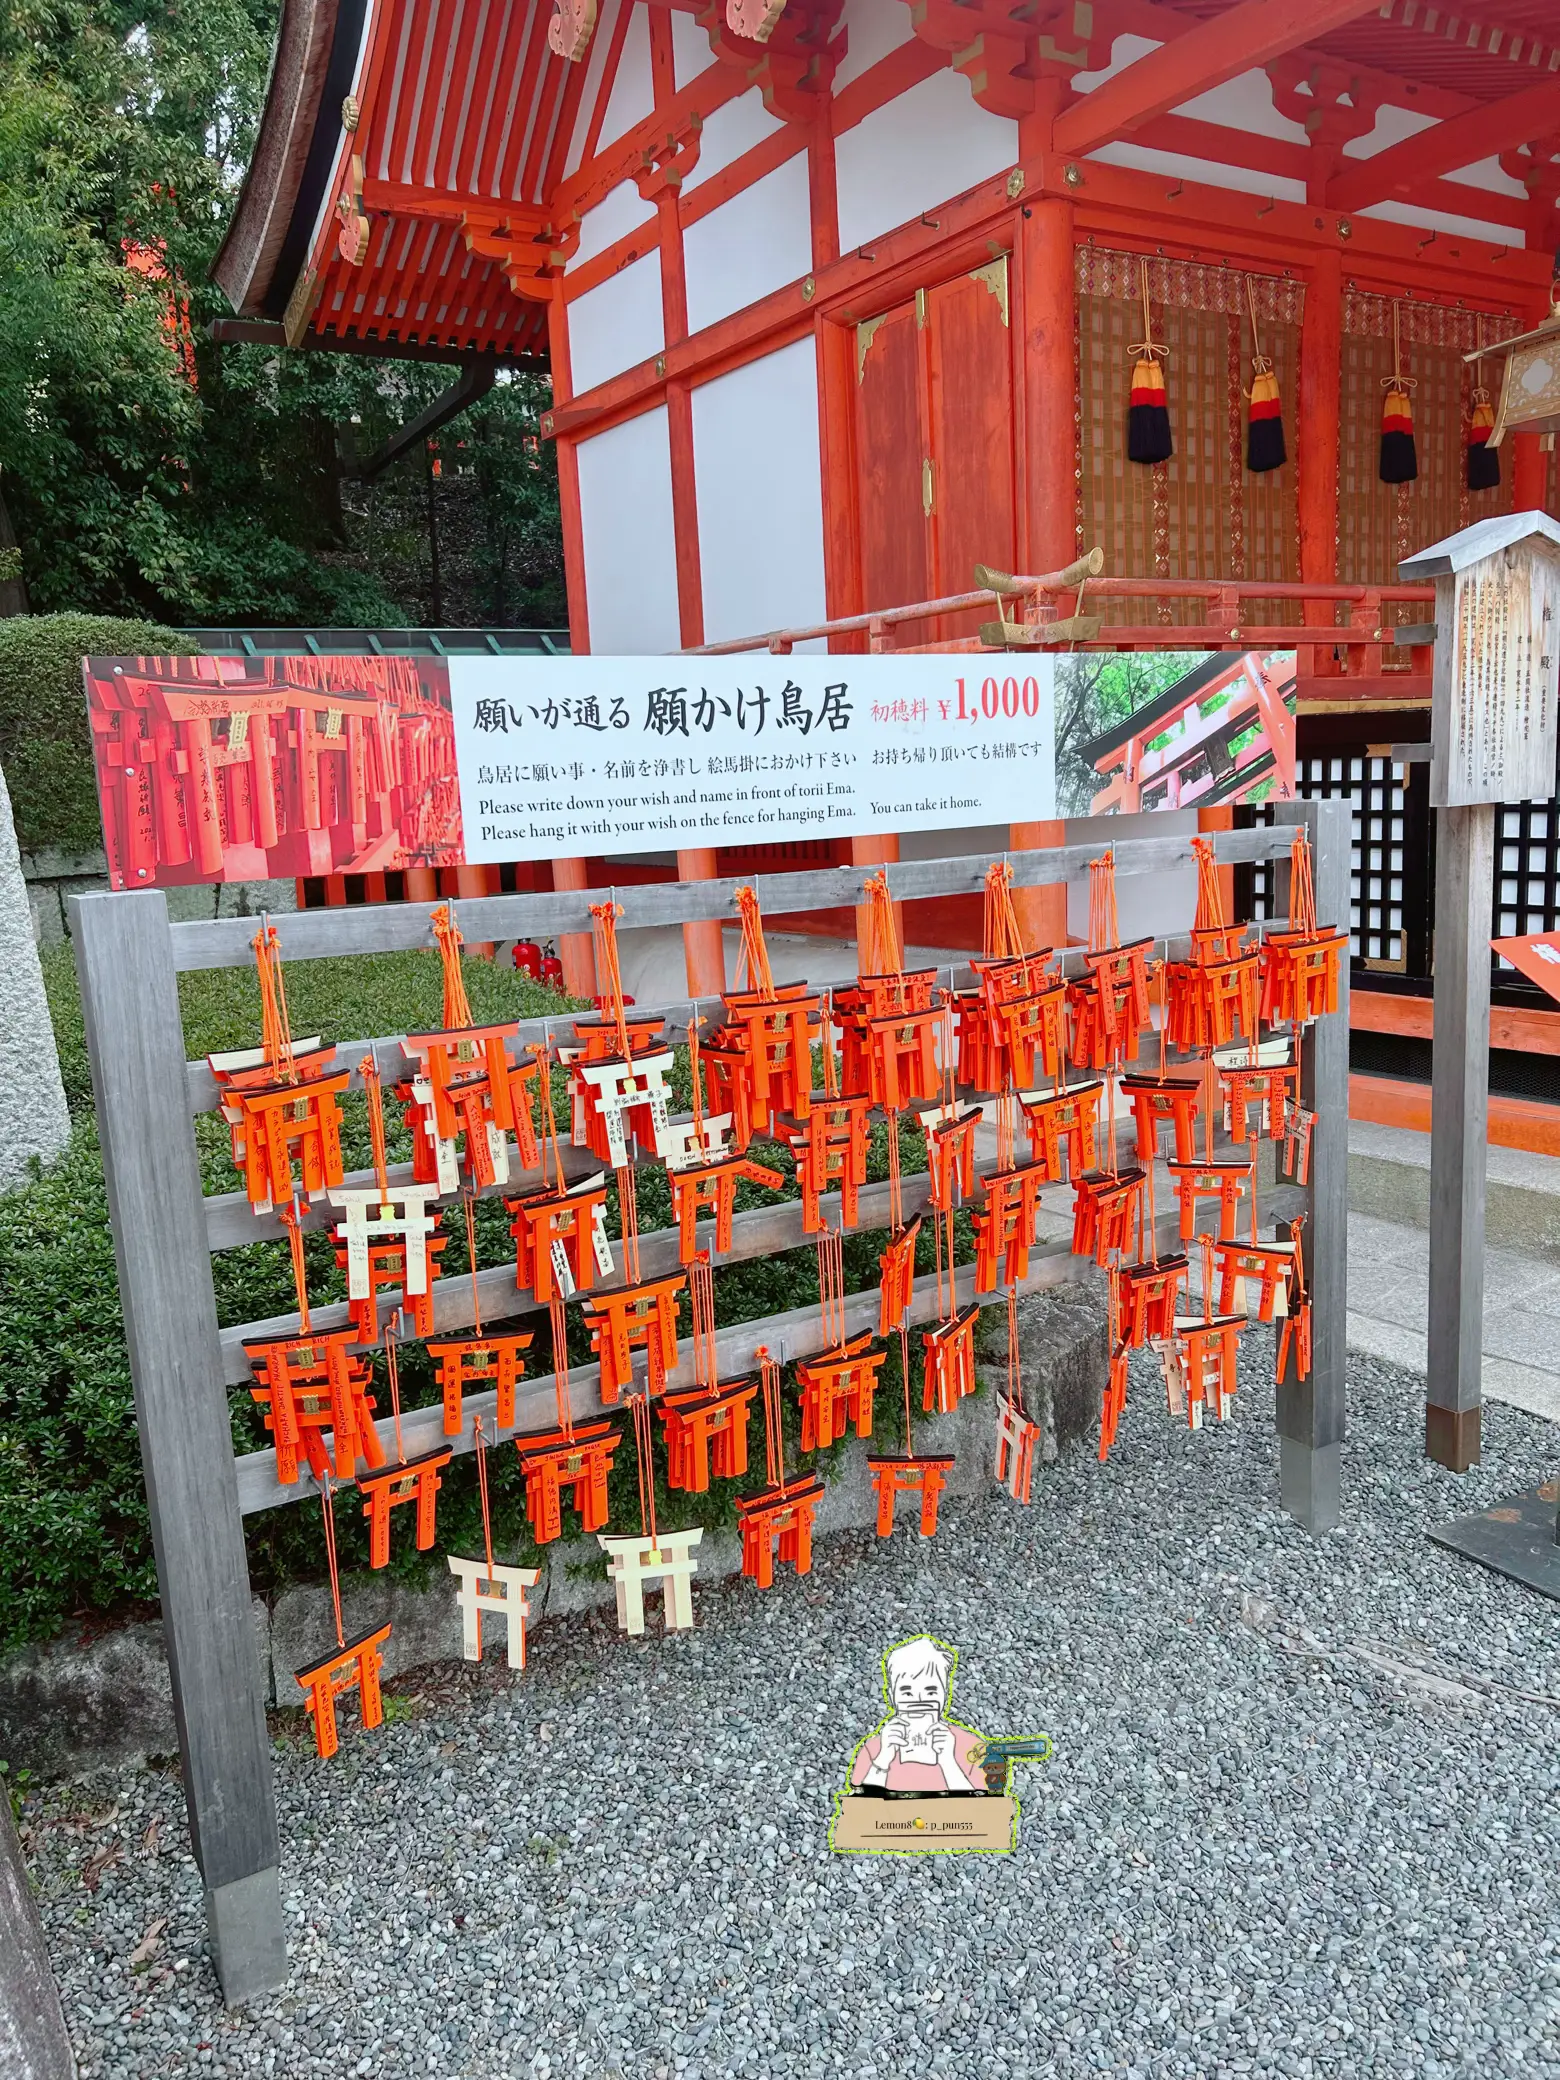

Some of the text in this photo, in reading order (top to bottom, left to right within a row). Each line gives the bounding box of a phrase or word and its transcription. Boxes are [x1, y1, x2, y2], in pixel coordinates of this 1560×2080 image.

[473, 679, 854, 737] 願いが通る 願かけ鳥居
[870, 676, 1040, 725] 初穂料 ¥1,000
[477, 742, 1042, 785] 鳥居に願い事・名前を浄書し 絵馬掛におかけ下さい お持ち帰り頂いても結構です
[479, 782, 856, 815] Please write down your wish and name in front of torii Ema.
[870, 795, 983, 815] You can take it home.
[481, 804, 857, 841] Please hang it with your wish on the fence for hanging Ema.
